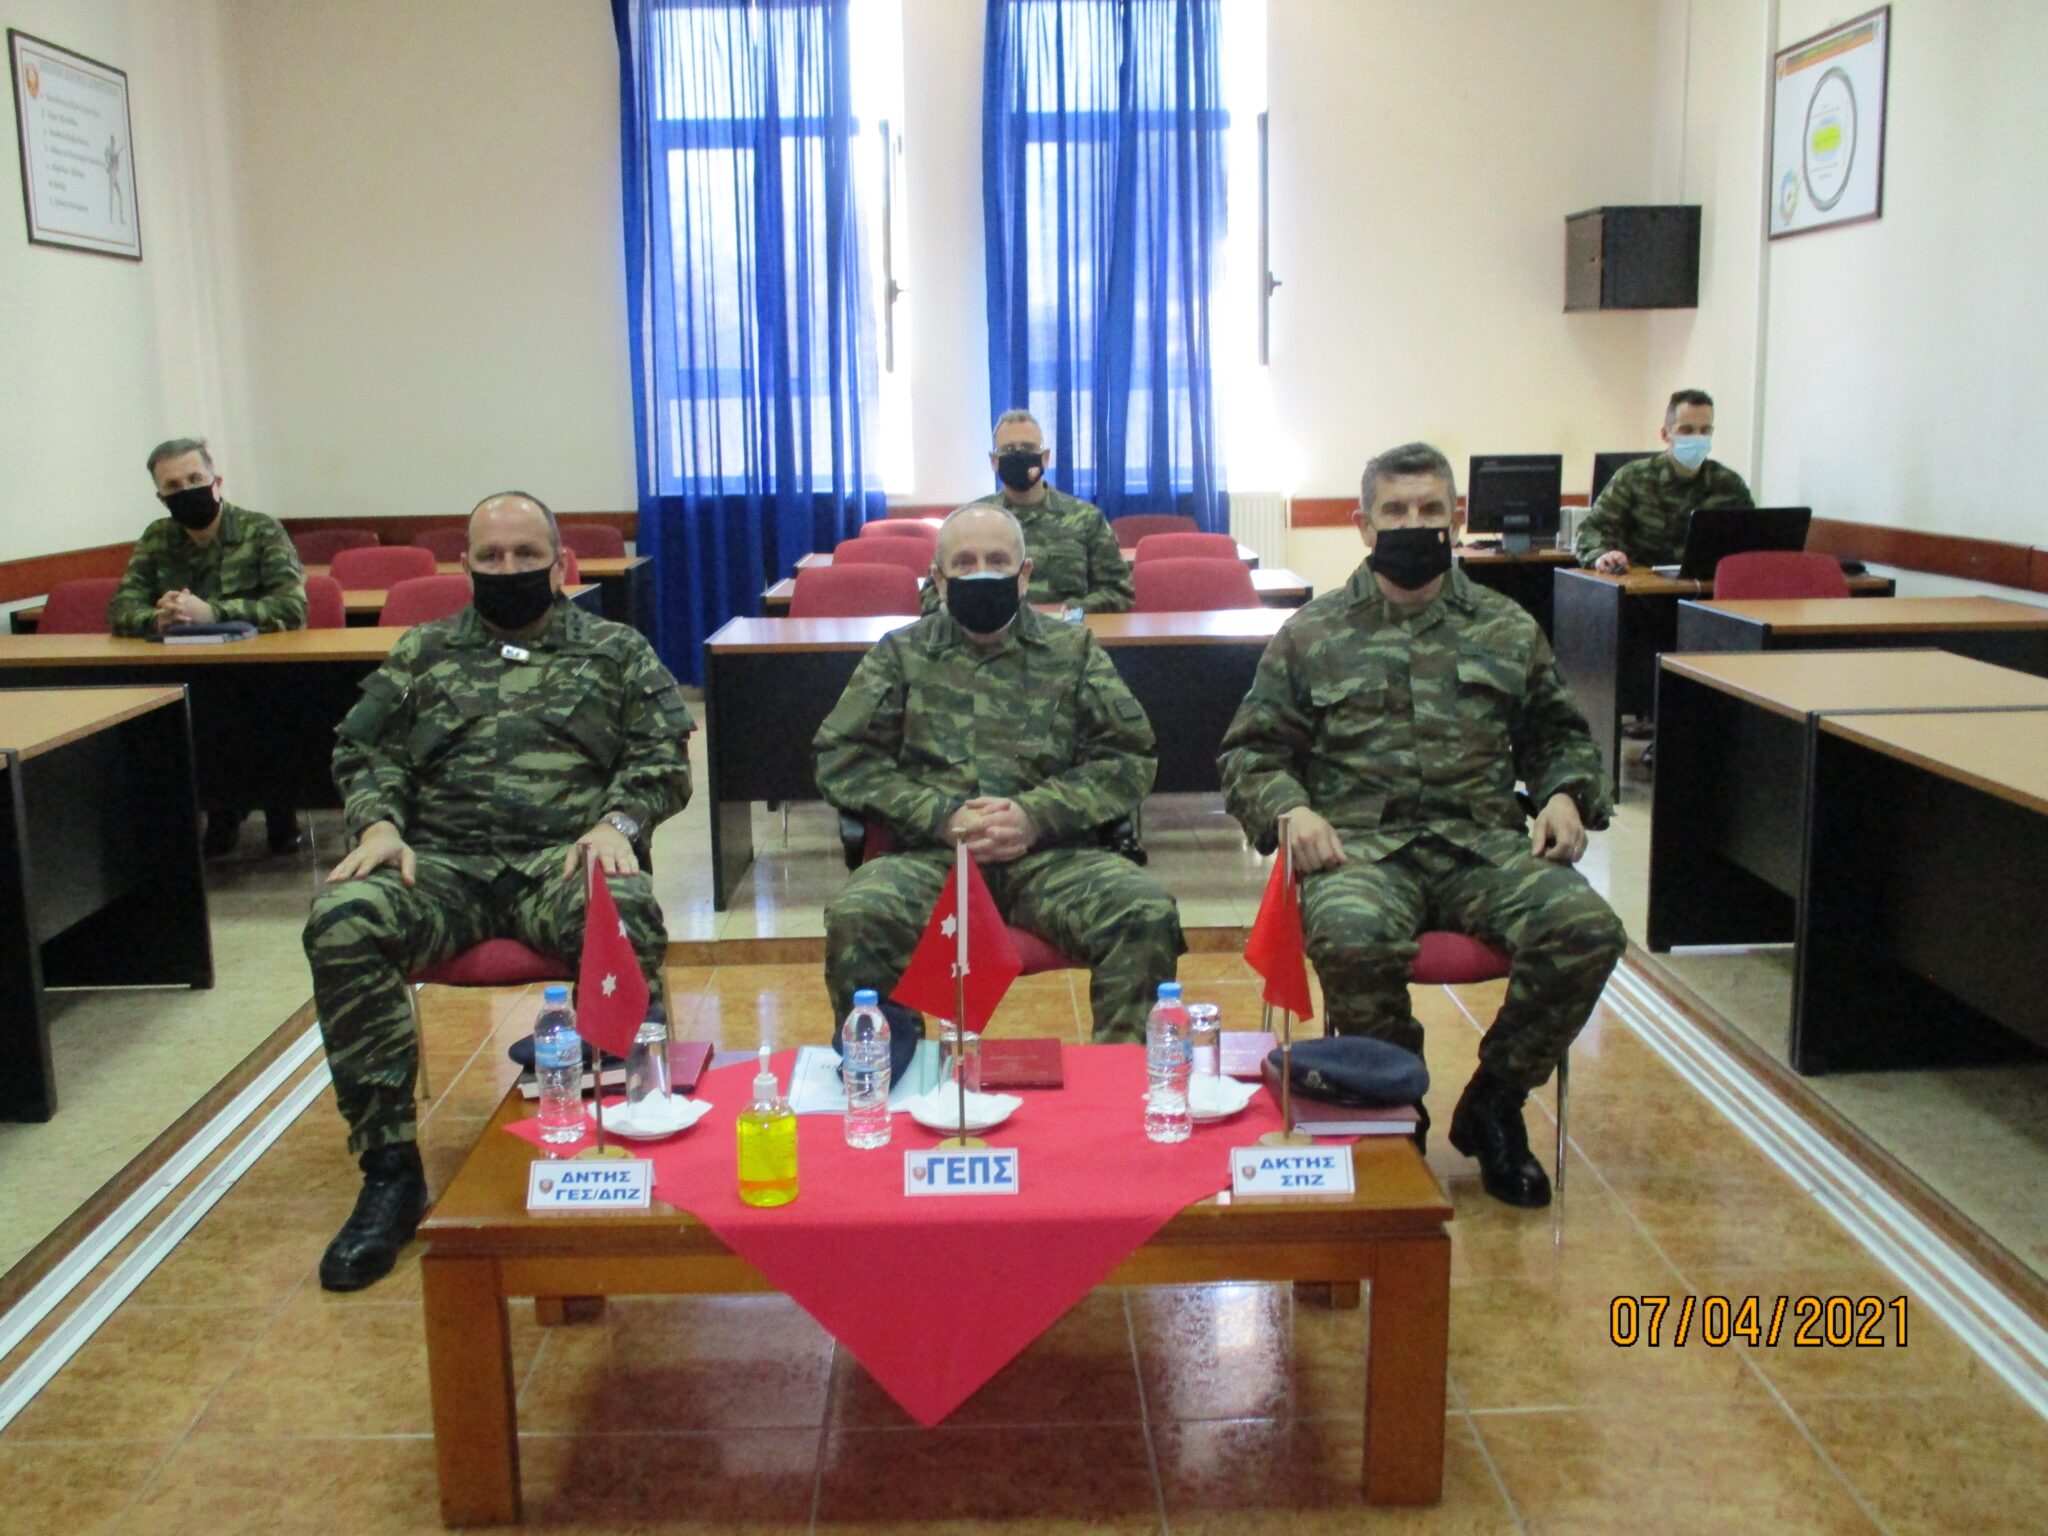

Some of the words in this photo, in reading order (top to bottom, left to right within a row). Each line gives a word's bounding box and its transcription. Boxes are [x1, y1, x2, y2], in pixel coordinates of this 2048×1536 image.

[1260, 1156, 1335, 1169] ΔΚΤΗΣ
[561, 1170, 631, 1183] ΔΝΤΗΣ
[927, 1156, 1012, 1185] ΓΕΠΣ
[1281, 1174, 1325, 1187] ΣΠΖ
[555, 1188, 641, 1201] ΓΕΣ/ΔΠΖ
